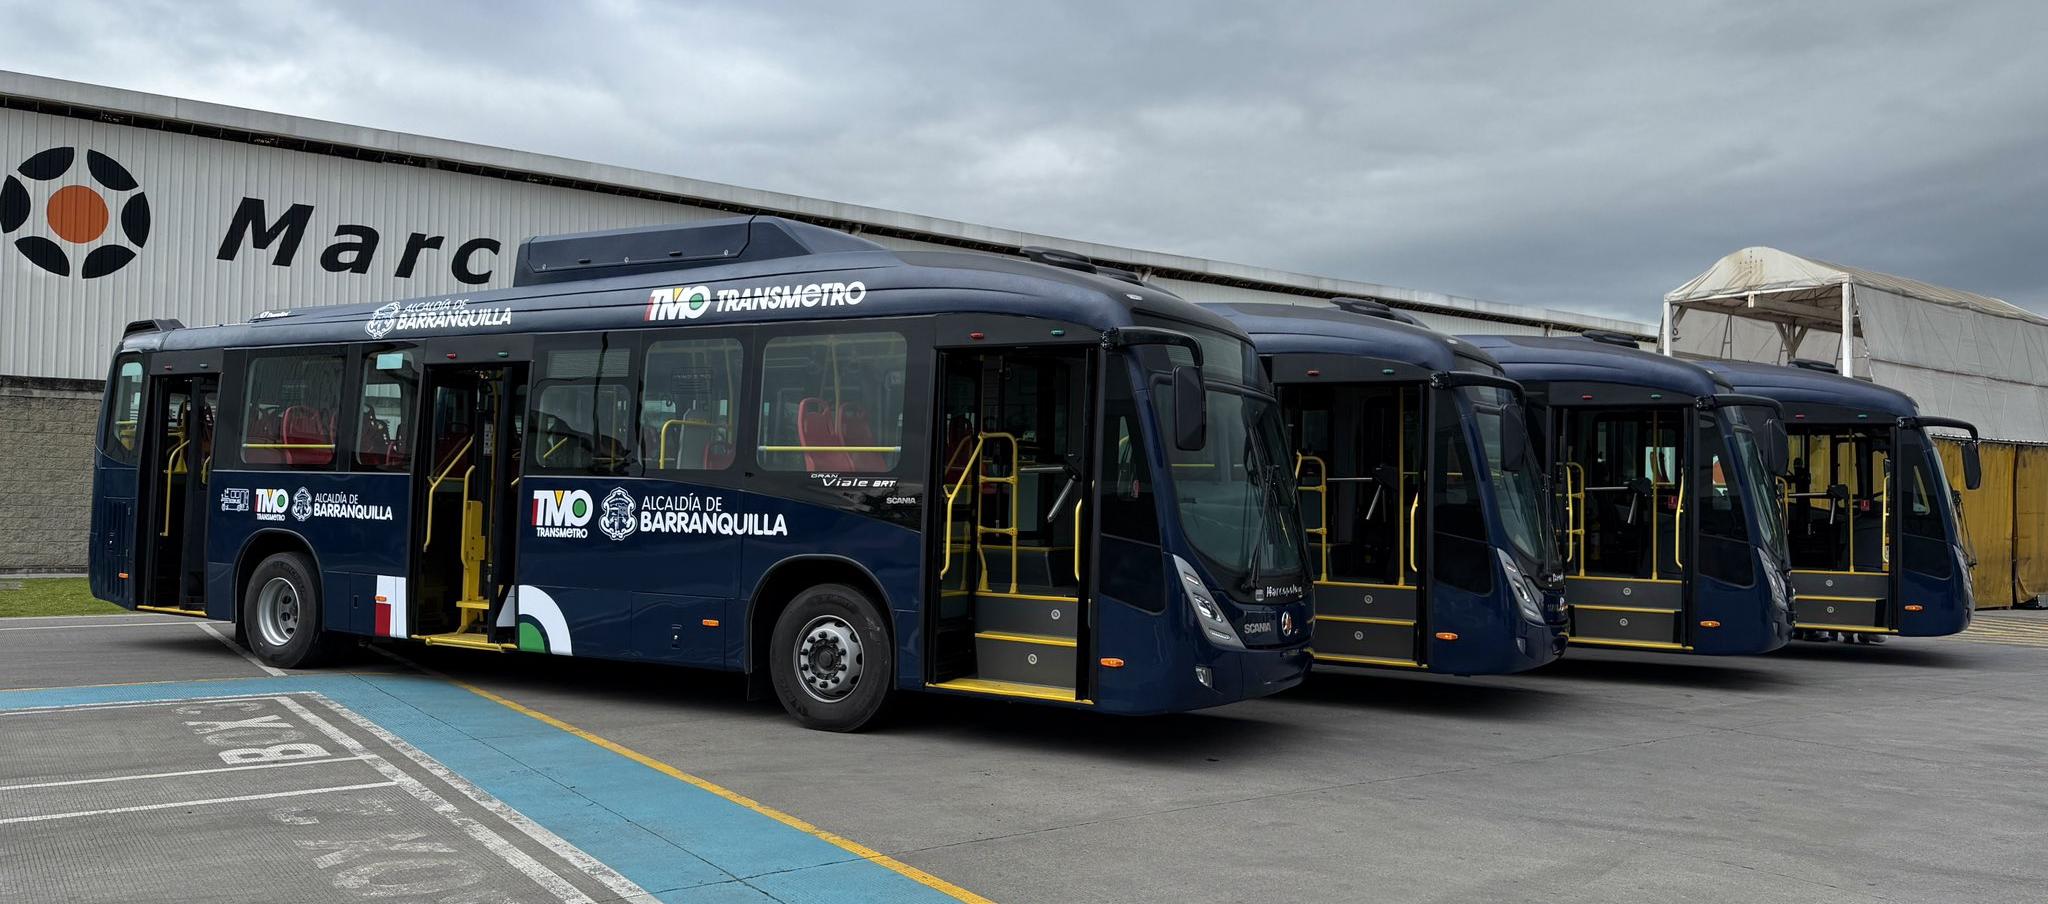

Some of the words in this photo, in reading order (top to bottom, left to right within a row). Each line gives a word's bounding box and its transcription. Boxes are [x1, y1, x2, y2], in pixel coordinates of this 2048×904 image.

[216, 196, 502, 285] Marc
[402, 298, 452, 313] ALCALDÍA
[453, 298, 469, 310] DE
[643, 285, 711, 321] TMO
[396, 307, 512, 330] BARRANQUILLA
[822, 478, 869, 487] Viale
[873, 480, 896, 488] BRT
[254, 488, 289, 513] TMO
[314, 491, 348, 504] ALCALDÍA
[349, 494, 359, 504] DE
[532, 489, 593, 527] TMO
[641, 493, 702, 512] ALCALDÍA
[706, 496, 722, 512] DE
[313, 503, 393, 520] BARRANQUILLA
[640, 511, 788, 536] BARRANQUILLA
[1244, 622, 1272, 634] SCANIA
